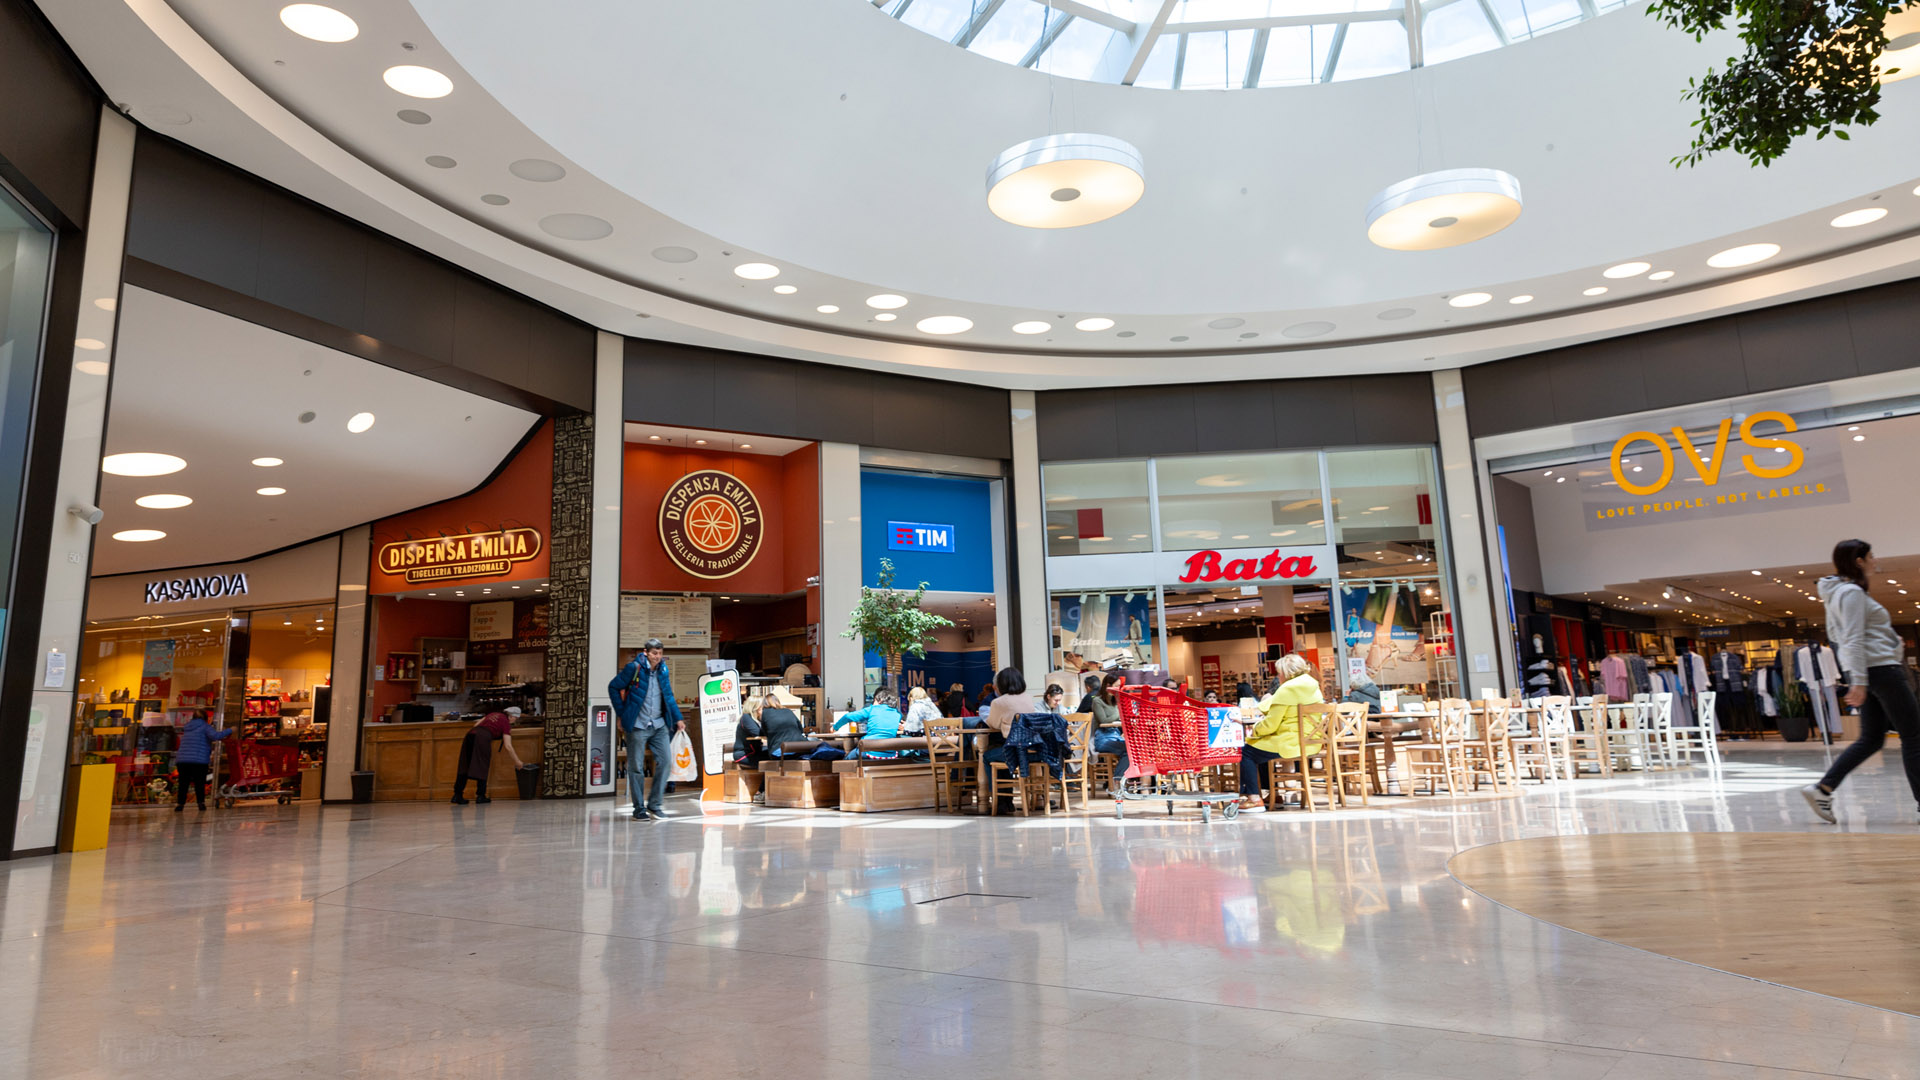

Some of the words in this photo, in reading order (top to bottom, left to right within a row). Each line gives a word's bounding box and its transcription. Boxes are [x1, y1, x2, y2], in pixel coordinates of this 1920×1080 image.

[1610, 411, 1804, 496] OVS
[666, 477, 720, 521] DISPENSA
[723, 481, 756, 526] EMILIA
[1597, 505, 1636, 520] LOVE
[1643, 498, 1709, 514] PEOPLE.
[1717, 491, 1748, 505] NOT
[1757, 483, 1832, 500] LABELS.
[390, 541, 466, 567] DISPENSA
[471, 534, 527, 558] EMILIA
[669, 530, 704, 568] TIGELLERIA
[707, 533, 753, 569] TRADIZIONALE
[915, 528, 947, 547] TIM
[412, 566, 452, 579] TIGELLERIA
[453, 562, 505, 576] TRADIZIONALE
[1179, 549, 1317, 583] Bata
[144, 573, 248, 603] KASANOVA
[532, 638, 548, 647] dolc
[908, 670, 924, 688] IM
